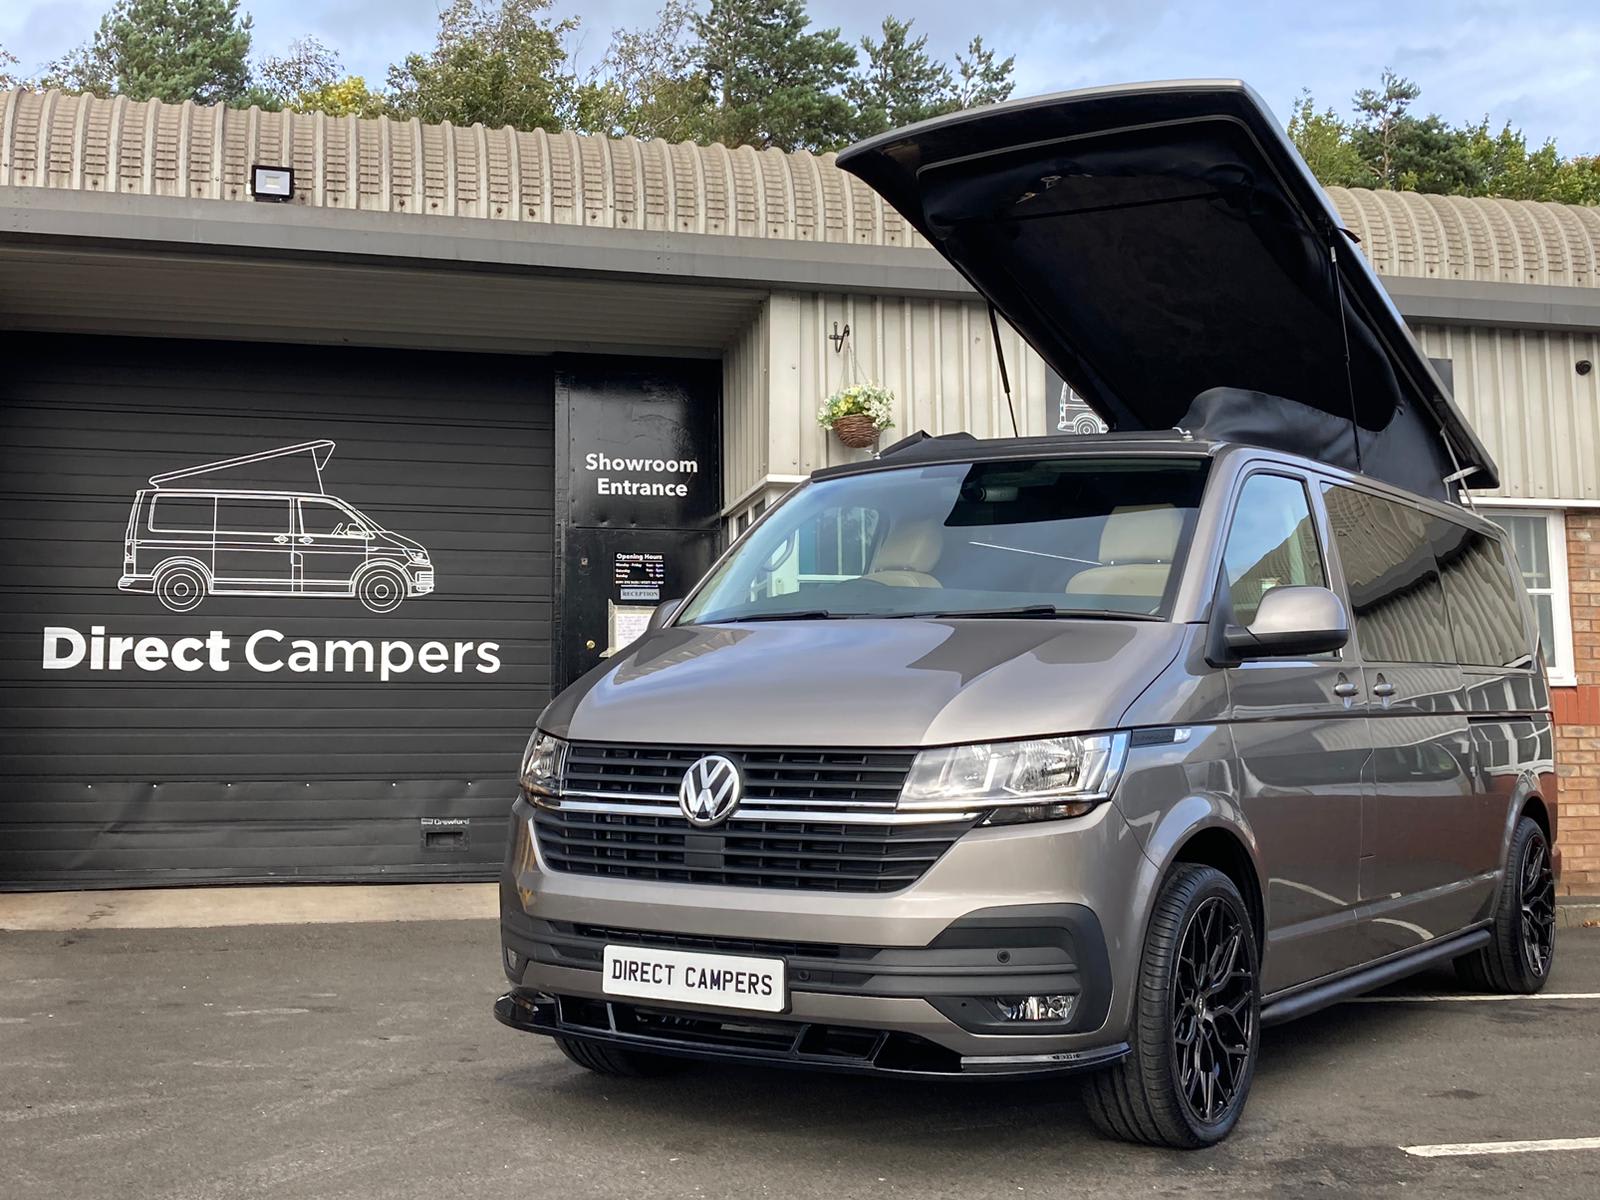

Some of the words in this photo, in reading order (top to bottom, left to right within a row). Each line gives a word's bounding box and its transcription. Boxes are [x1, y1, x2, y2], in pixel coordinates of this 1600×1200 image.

[585, 453, 698, 473] Showroom
[597, 478, 688, 496] Entrance
[616, 553, 643, 561] Opening
[42, 626, 230, 672] Direct
[244, 629, 501, 682] Campers
[612, 959, 675, 985] DIRECT
[685, 967, 773, 996] CAMPERS
